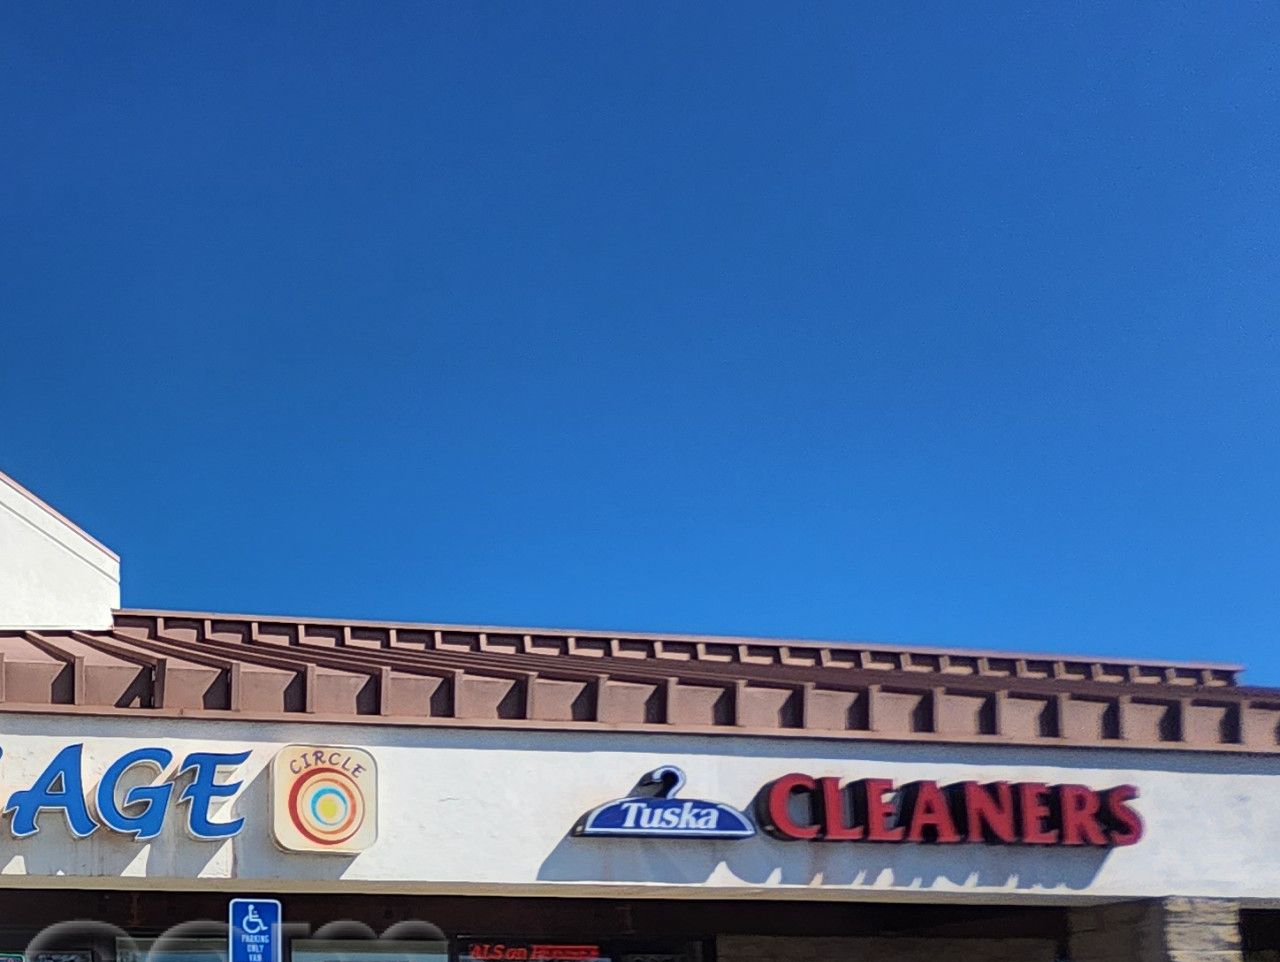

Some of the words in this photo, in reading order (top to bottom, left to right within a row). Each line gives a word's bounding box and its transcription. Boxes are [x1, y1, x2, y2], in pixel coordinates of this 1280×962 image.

[289, 748, 367, 780] CIRCLE
[620, 799, 719, 832] Tuska
[764, 772, 1144, 848] CLEANERS
[241, 934, 270, 944] PARKING
[247, 944, 264, 953] ONLY
[249, 953, 263, 962] VAN
